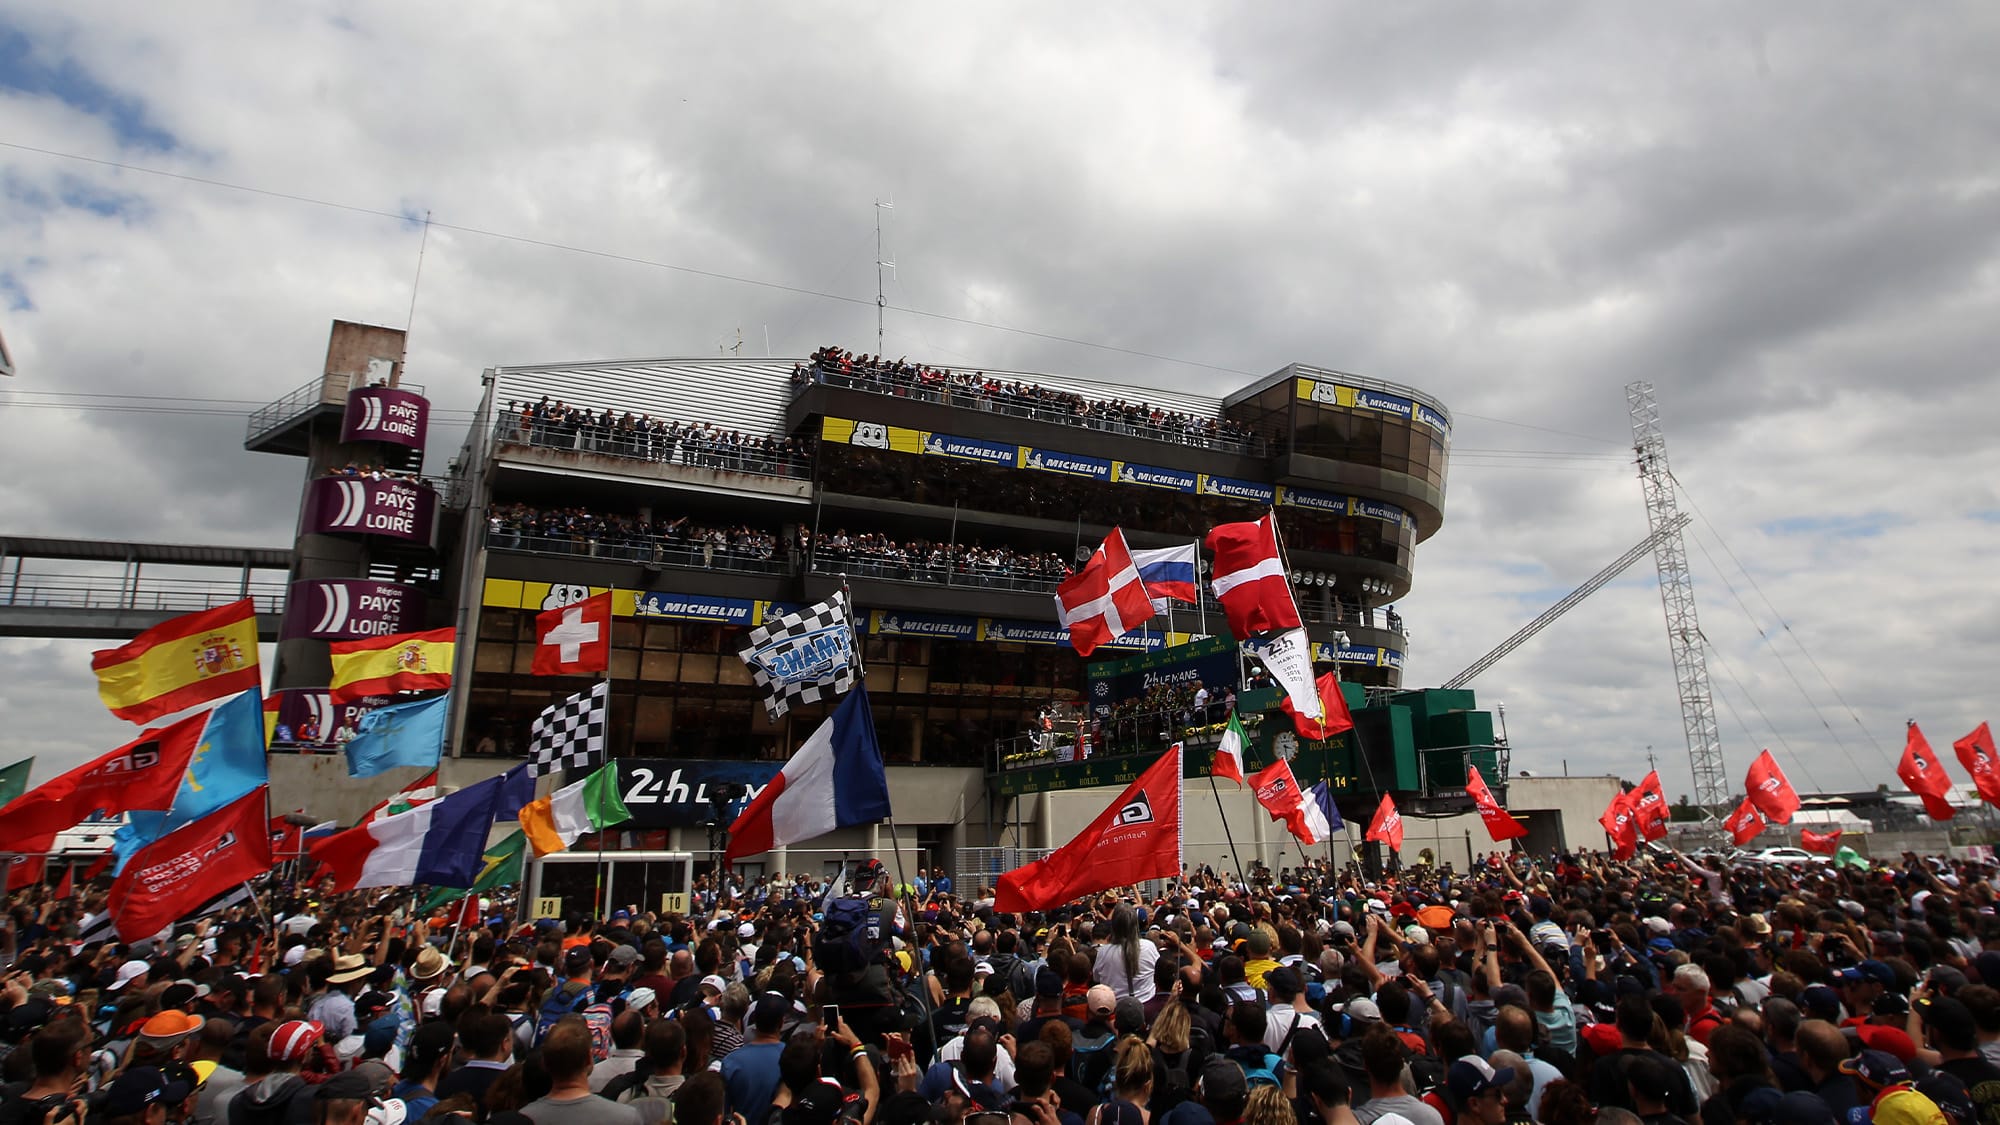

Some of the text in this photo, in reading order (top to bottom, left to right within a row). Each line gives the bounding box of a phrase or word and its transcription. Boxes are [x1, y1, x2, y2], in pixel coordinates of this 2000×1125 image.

[389, 404, 418, 421] PAYS
[1369, 398, 1411, 414] MICHELIN
[382, 421, 416, 437] LOIRE
[946, 443, 1013, 461] MICHELIN
[1046, 458, 1107, 475] MICHELIN
[1137, 472, 1194, 488] MICHELIN
[392, 485, 417, 496] Région
[1220, 484, 1272, 499] MICHELIN
[375, 491, 416, 511] PAYS
[1297, 496, 1345, 510] MICHELIN
[1367, 506, 1401, 521] MICHELIN
[366, 513, 413, 533] LOIRE
[376, 586, 403, 596] Région
[359, 595, 402, 613] PAYS
[663, 602, 748, 618] MICHELIN
[350, 618, 399, 635] LOIRE
[902, 620, 973, 635] MICHELIN
[1006, 628, 1071, 641] MICHELIN
[1108, 636, 1160, 647] ICHELIN
[1333, 651, 1376, 660] MICHELIN
[1309, 739, 1344, 750] ROLEX
[1080, 776, 1100, 785] ROLEX
[1115, 773, 1137, 783] ROLEX
